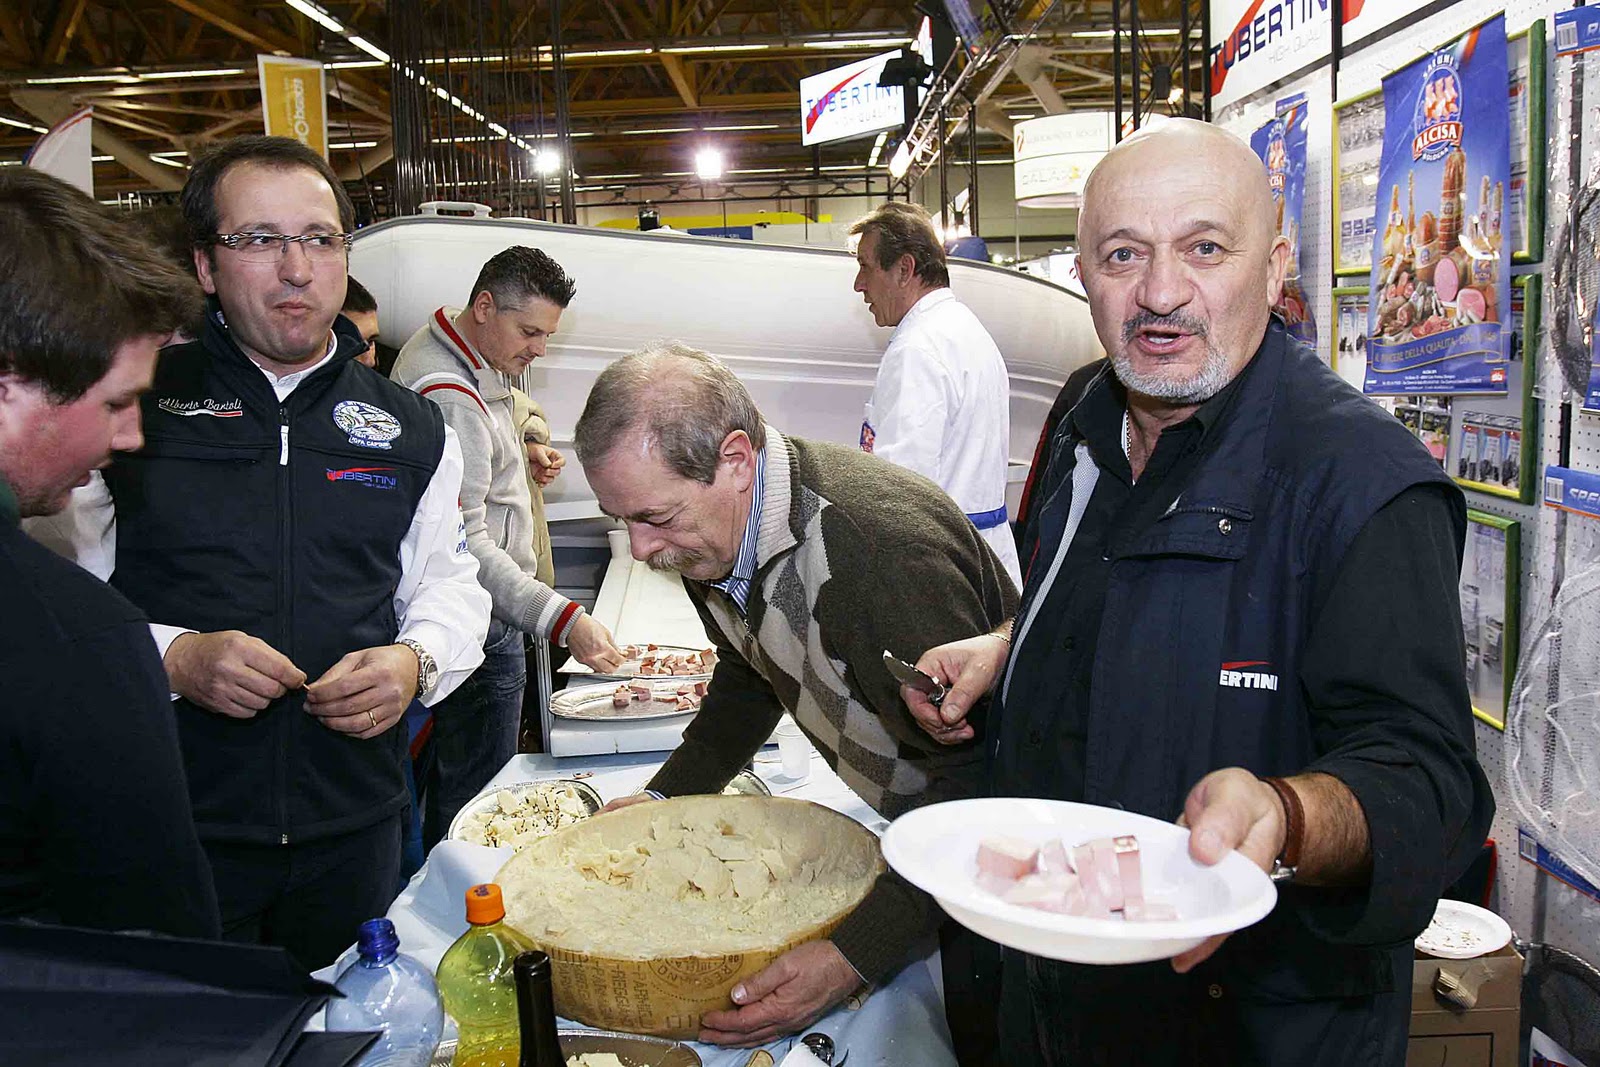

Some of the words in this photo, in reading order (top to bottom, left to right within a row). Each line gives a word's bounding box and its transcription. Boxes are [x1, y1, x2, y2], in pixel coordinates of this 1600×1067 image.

[1209, 0, 1329, 76] TUBERTIN
[1415, 124, 1458, 152] ALCISA
[158, 397, 200, 410] Alberto
[326, 468, 397, 486] TUBERTINI
[1569, 488, 1600, 504] SPE
[1219, 669, 1278, 691] ERTINI
